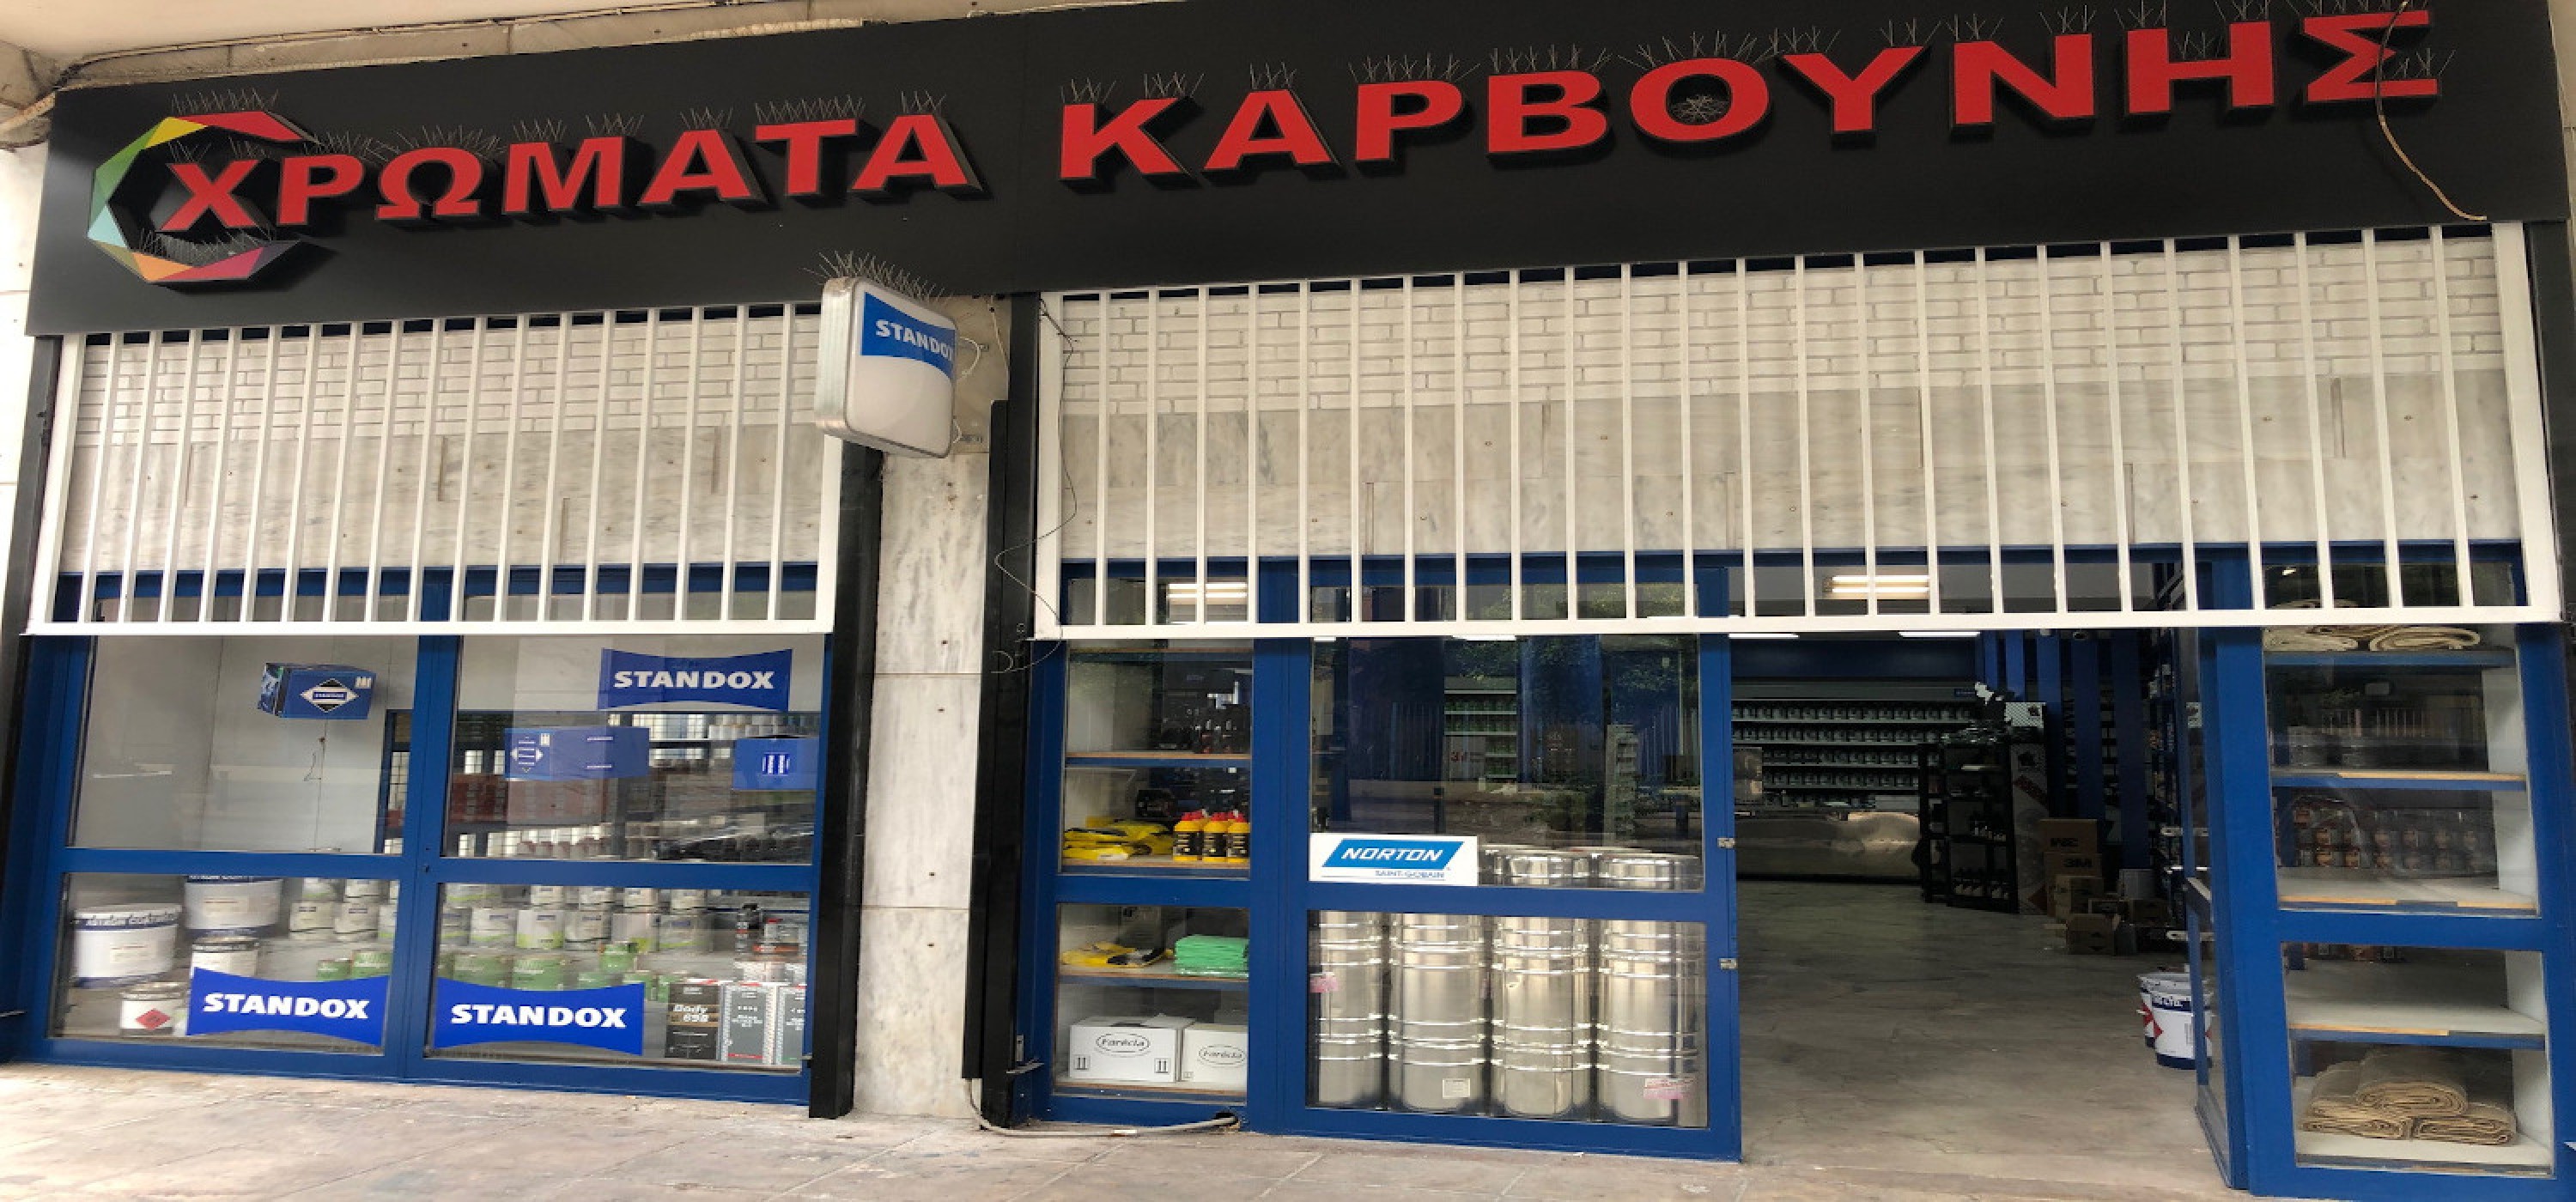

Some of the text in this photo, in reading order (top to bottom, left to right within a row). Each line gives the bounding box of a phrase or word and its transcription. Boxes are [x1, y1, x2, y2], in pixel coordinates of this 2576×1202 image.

[163, 11, 2440, 230] ΧΡΩΜΑΤΑ ΚΑΡΒΟΥΝΗΣ
[614, 671, 775, 689] STANDOX
[1340, 847, 1443, 862] NORTON
[203, 992, 370, 1020] STANDOX
[450, 1004, 627, 1029] STANDOX
